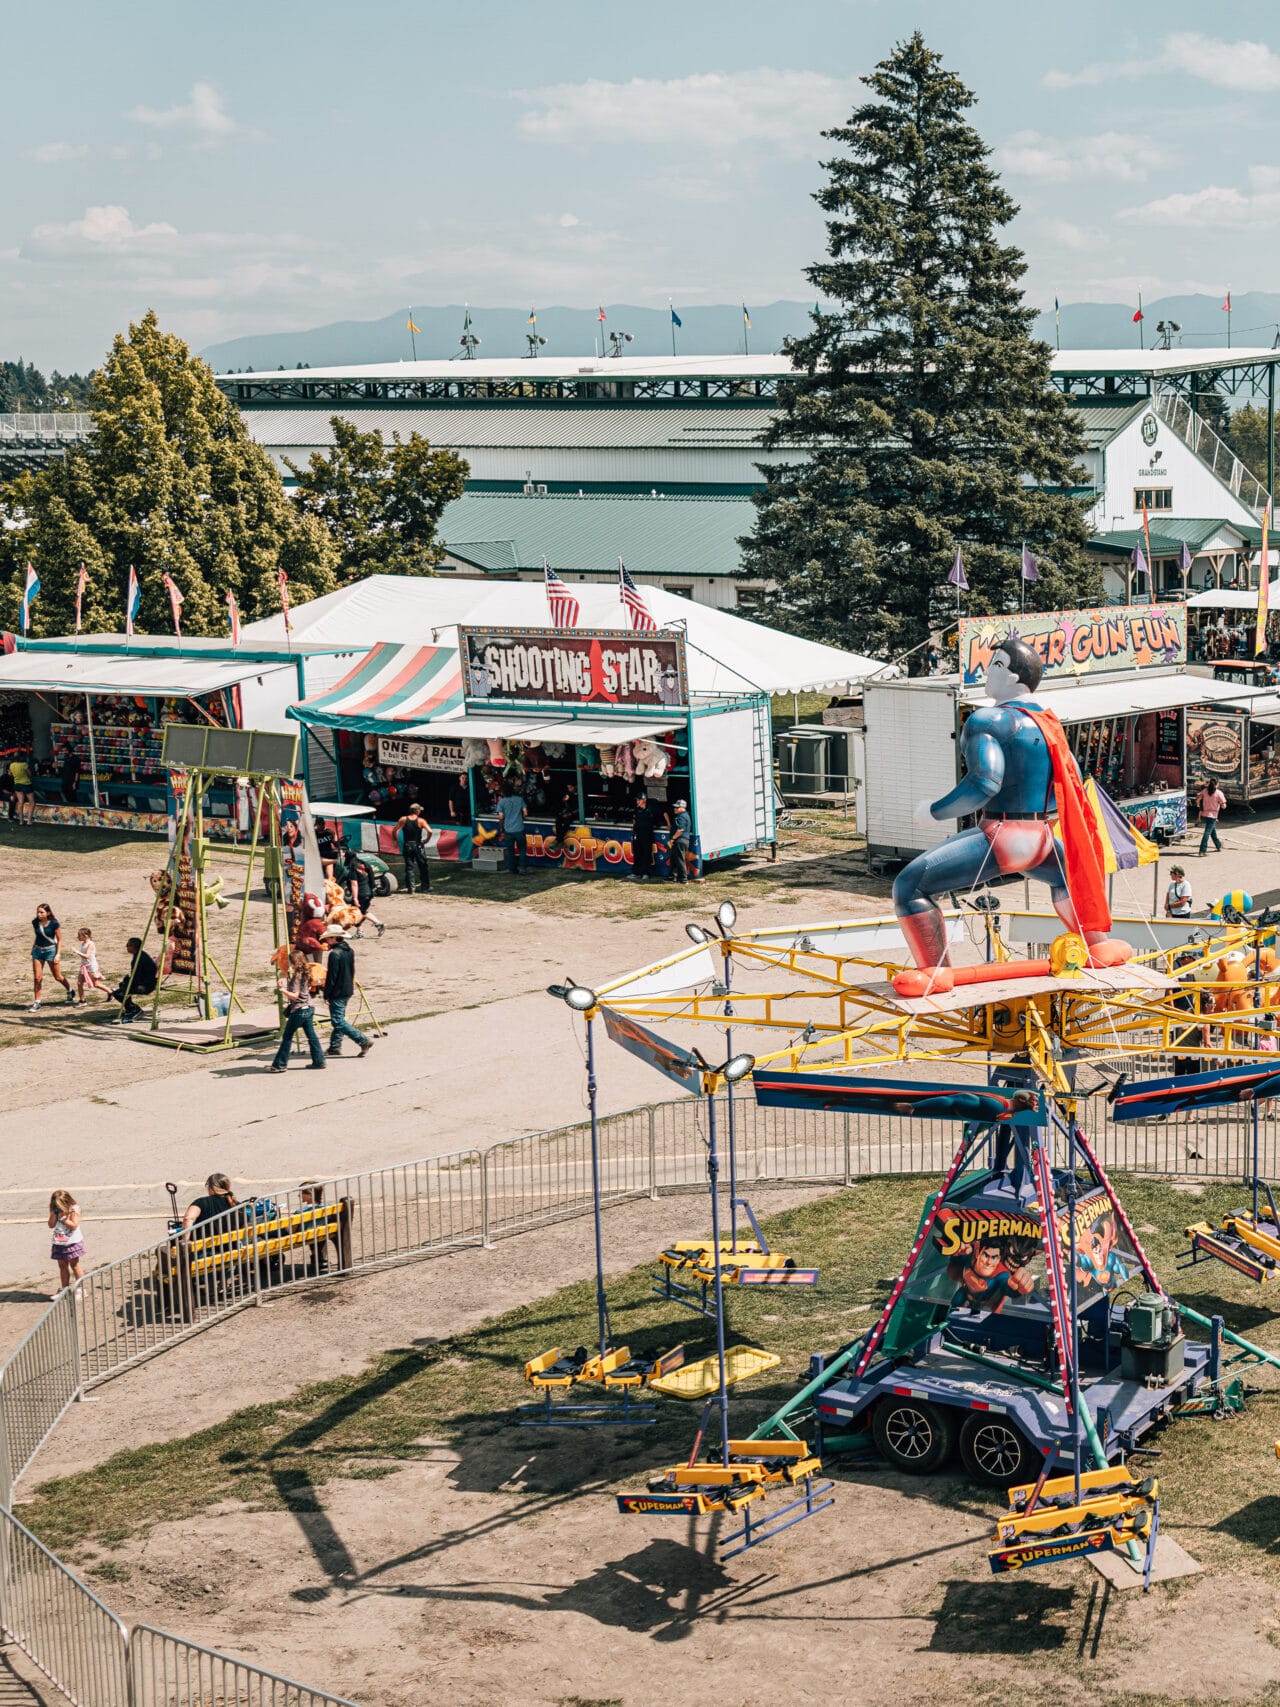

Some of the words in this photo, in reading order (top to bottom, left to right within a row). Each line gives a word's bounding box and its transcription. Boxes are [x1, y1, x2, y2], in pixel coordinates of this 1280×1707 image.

[1072, 619, 1128, 662] GUN
[1130, 617, 1183, 651] FUN
[485, 645, 592, 696] SHOOTING
[601, 647, 659, 697] STAR
[382, 740, 409, 753] ONE
[431, 746, 465, 759] BALL
[514, 834, 597, 862] HOOT
[941, 1217, 1043, 1257] SUPERMAN
[628, 1500, 685, 1514] SUPERMAN
[1006, 1540, 1090, 1571] SUPERMAN
